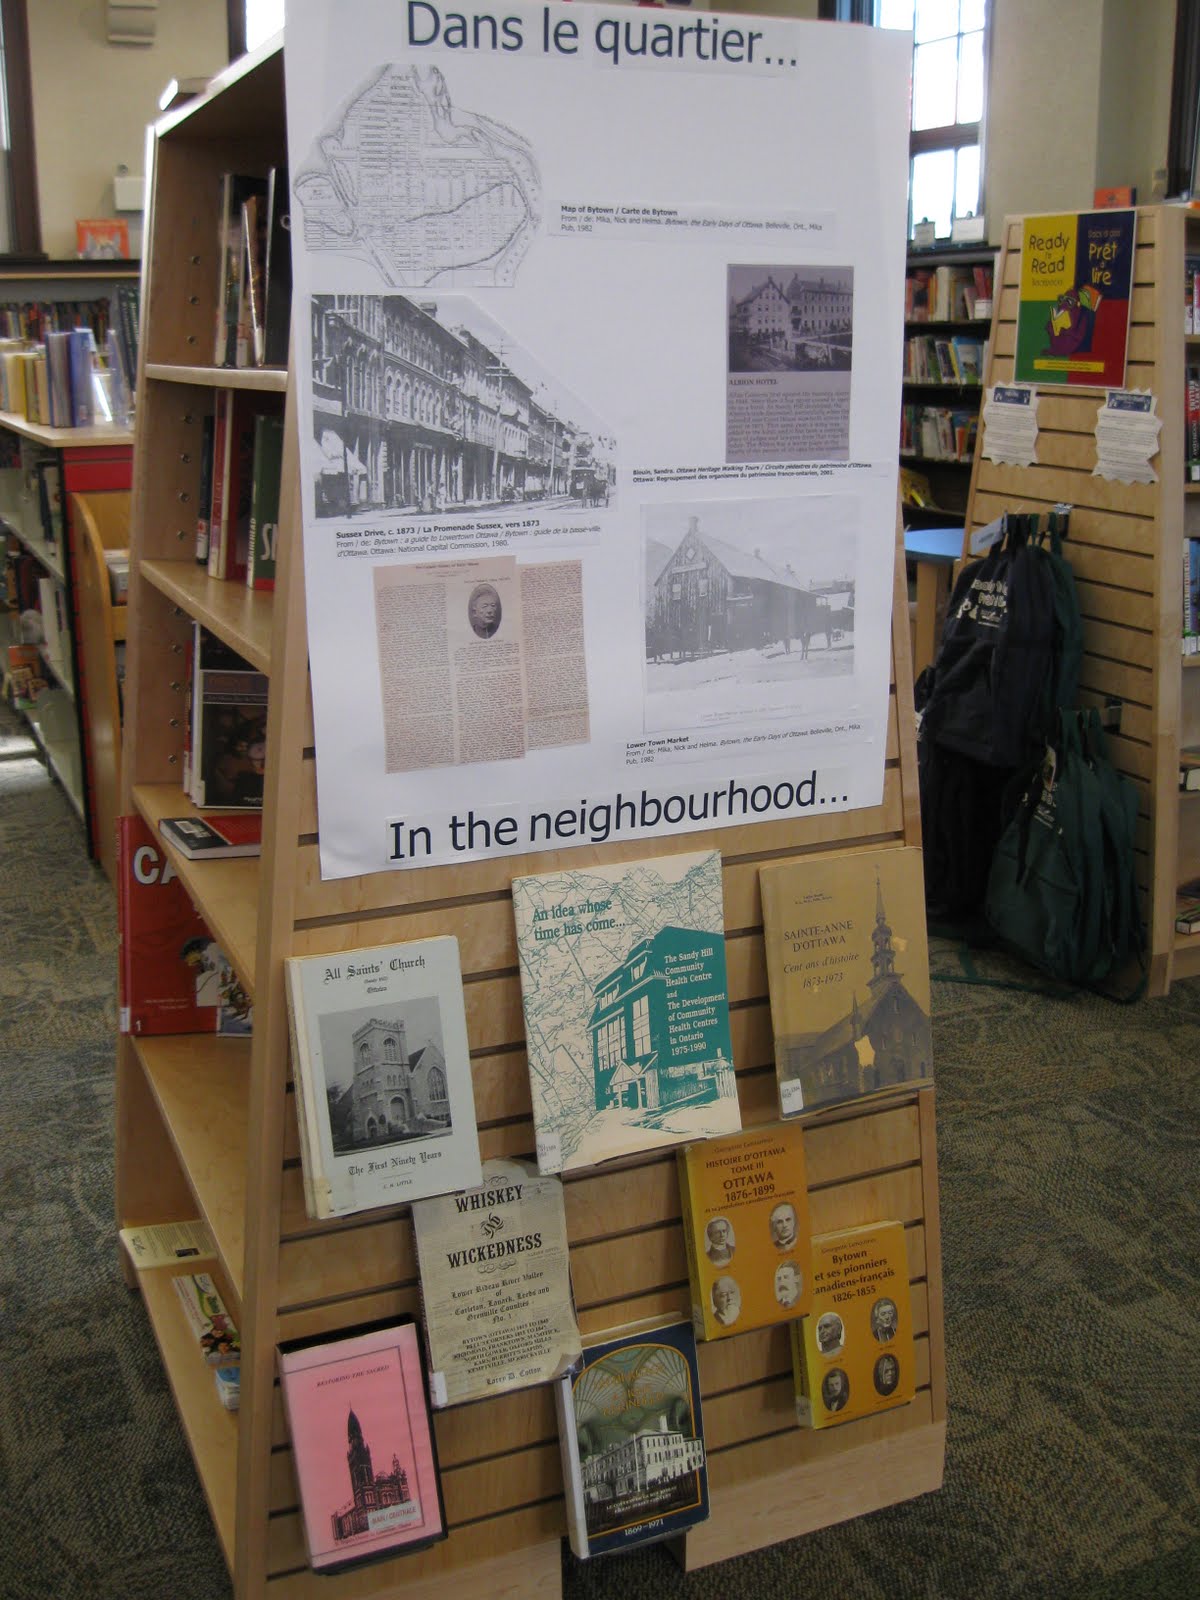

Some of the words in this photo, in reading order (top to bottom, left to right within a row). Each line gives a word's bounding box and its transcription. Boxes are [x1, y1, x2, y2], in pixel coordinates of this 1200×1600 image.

[408, 1, 524, 52] Dans
[543, 8, 579, 54] le
[595, 19, 797, 67] quartier...
[561, 206, 576, 214] Map
[587, 206, 614, 215] Bytown
[652, 209, 678, 217] Bytown
[718, 220, 733, 229] Days
[1029, 232, 1069, 251] Ready
[1089, 241, 1118, 260] Prêt
[1032, 256, 1064, 274] Read
[1092, 268, 1112, 285] lire
[365, 529, 386, 537] Drive,
[434, 523, 474, 532] Promenade
[374, 538, 398, 546] Bytown
[411, 536, 428, 544] guide
[439, 533, 474, 541] Lowertown
[534, 528, 551, 536] guide
[426, 543, 448, 551] Capital
[450, 542, 490, 550] Commission,
[389, 821, 432, 860] In
[449, 812, 518, 851] the
[530, 771, 849, 842] neighbourhood...
[533, 908, 548, 922] An
[552, 904, 575, 919] idea
[578, 899, 612, 914] whose
[534, 927, 560, 941] time
[564, 922, 582, 936] has
[586, 918, 625, 932] come...
[784, 920, 853, 941] SAINTE-ANNE
[793, 935, 846, 952] D'OTTAWA
[664, 955, 677, 963] The
[679, 951, 699, 961] Sandy
[701, 948, 713, 957] Hill
[784, 964, 802, 974] Cent
[806, 960, 819, 970] ans
[822, 953, 859, 967] d'histoire
[324, 968, 341, 985] All
[347, 961, 383, 980] Saints'
[390, 956, 425, 972] Church
[665, 962, 704, 975] Community
[666, 976, 688, 987] Health
[690, 972, 712, 982] Centre
[803, 972, 843, 988] 1873-1973
[667, 990, 677, 998] and
[667, 1002, 680, 1010] The
[682, 992, 725, 1008] Development
[668, 1013, 675, 1022] of
[677, 1007, 715, 1020] Community
[669, 1022, 691, 1033] Health
[693, 1017, 718, 1028] Centres
[679, 1032, 704, 1043] Ontario
[672, 1042, 706, 1056] 1975-1990
[348, 1166, 364, 1176] The
[368, 1161, 387, 1174] First
[391, 1156, 416, 1168] Ninety
[419, 1152, 442, 1163] Years
[706, 1155, 742, 1168] HISTOIRE
[744, 1147, 785, 1161] D'OTTAWA
[731, 1164, 754, 1174] TOME
[723, 1171, 774, 1190] OTTAWA
[455, 1184, 523, 1213] WHISKEY
[726, 1184, 775, 1202] 1876-1899
[447, 1232, 542, 1268] WICKEDNESS
[832, 1250, 867, 1264] Bytown
[827, 1270, 840, 1278] ses
[844, 1258, 887, 1276] pionniers
[451, 1289, 473, 1299] Lower
[476, 1282, 500, 1292] Rideau
[502, 1278, 520, 1287] River
[523, 1272, 543, 1280] Valley
[833, 1285, 876, 1302] 1826-1855
[488, 1296, 515, 1307] Lanark,
[517, 1290, 536, 1300] Leeds
[467, 1309, 498, 1321] Grenville
[500, 1300, 529, 1312] Counties
[462, 1334, 488, 1344] BYTOWN
[624, 1518, 664, 1536] 1869-1971
